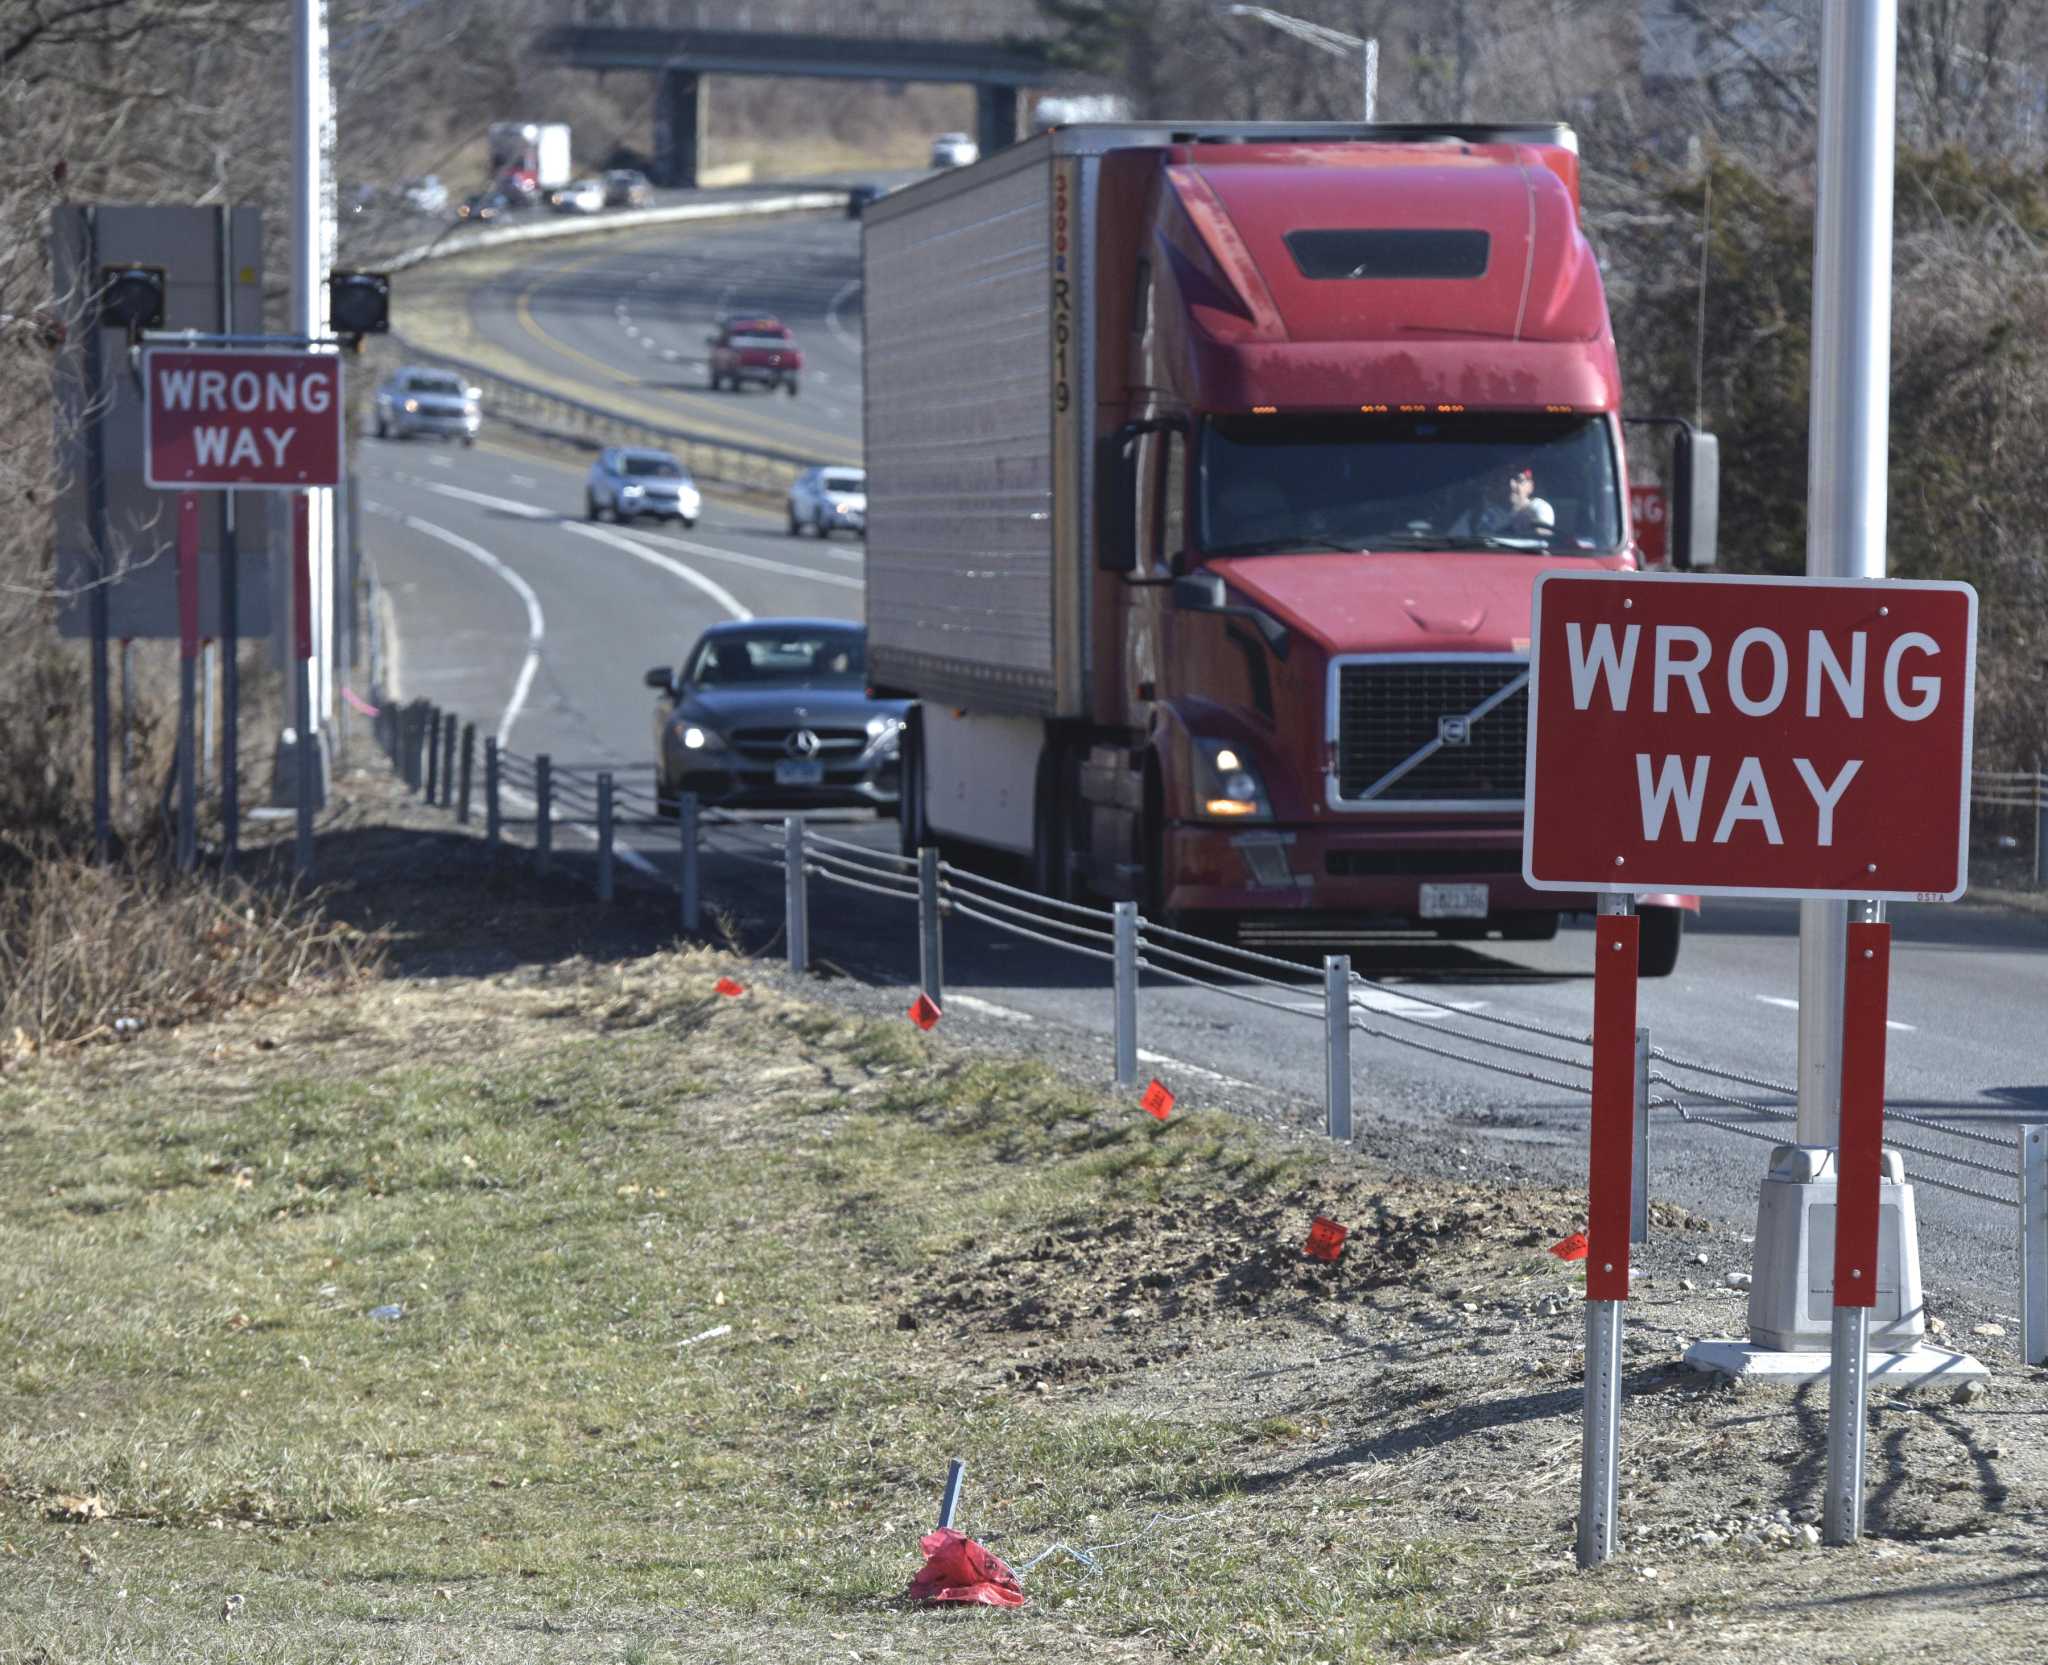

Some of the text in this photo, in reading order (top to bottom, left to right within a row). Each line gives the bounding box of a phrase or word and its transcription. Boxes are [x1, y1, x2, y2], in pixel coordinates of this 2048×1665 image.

[159, 369, 331, 414] WRONG
[1054, 278, 1070, 413] R619
[193, 425, 297, 468] WAY
[1565, 622, 1942, 722] WRONG
[1635, 753, 1864, 847] WAY
